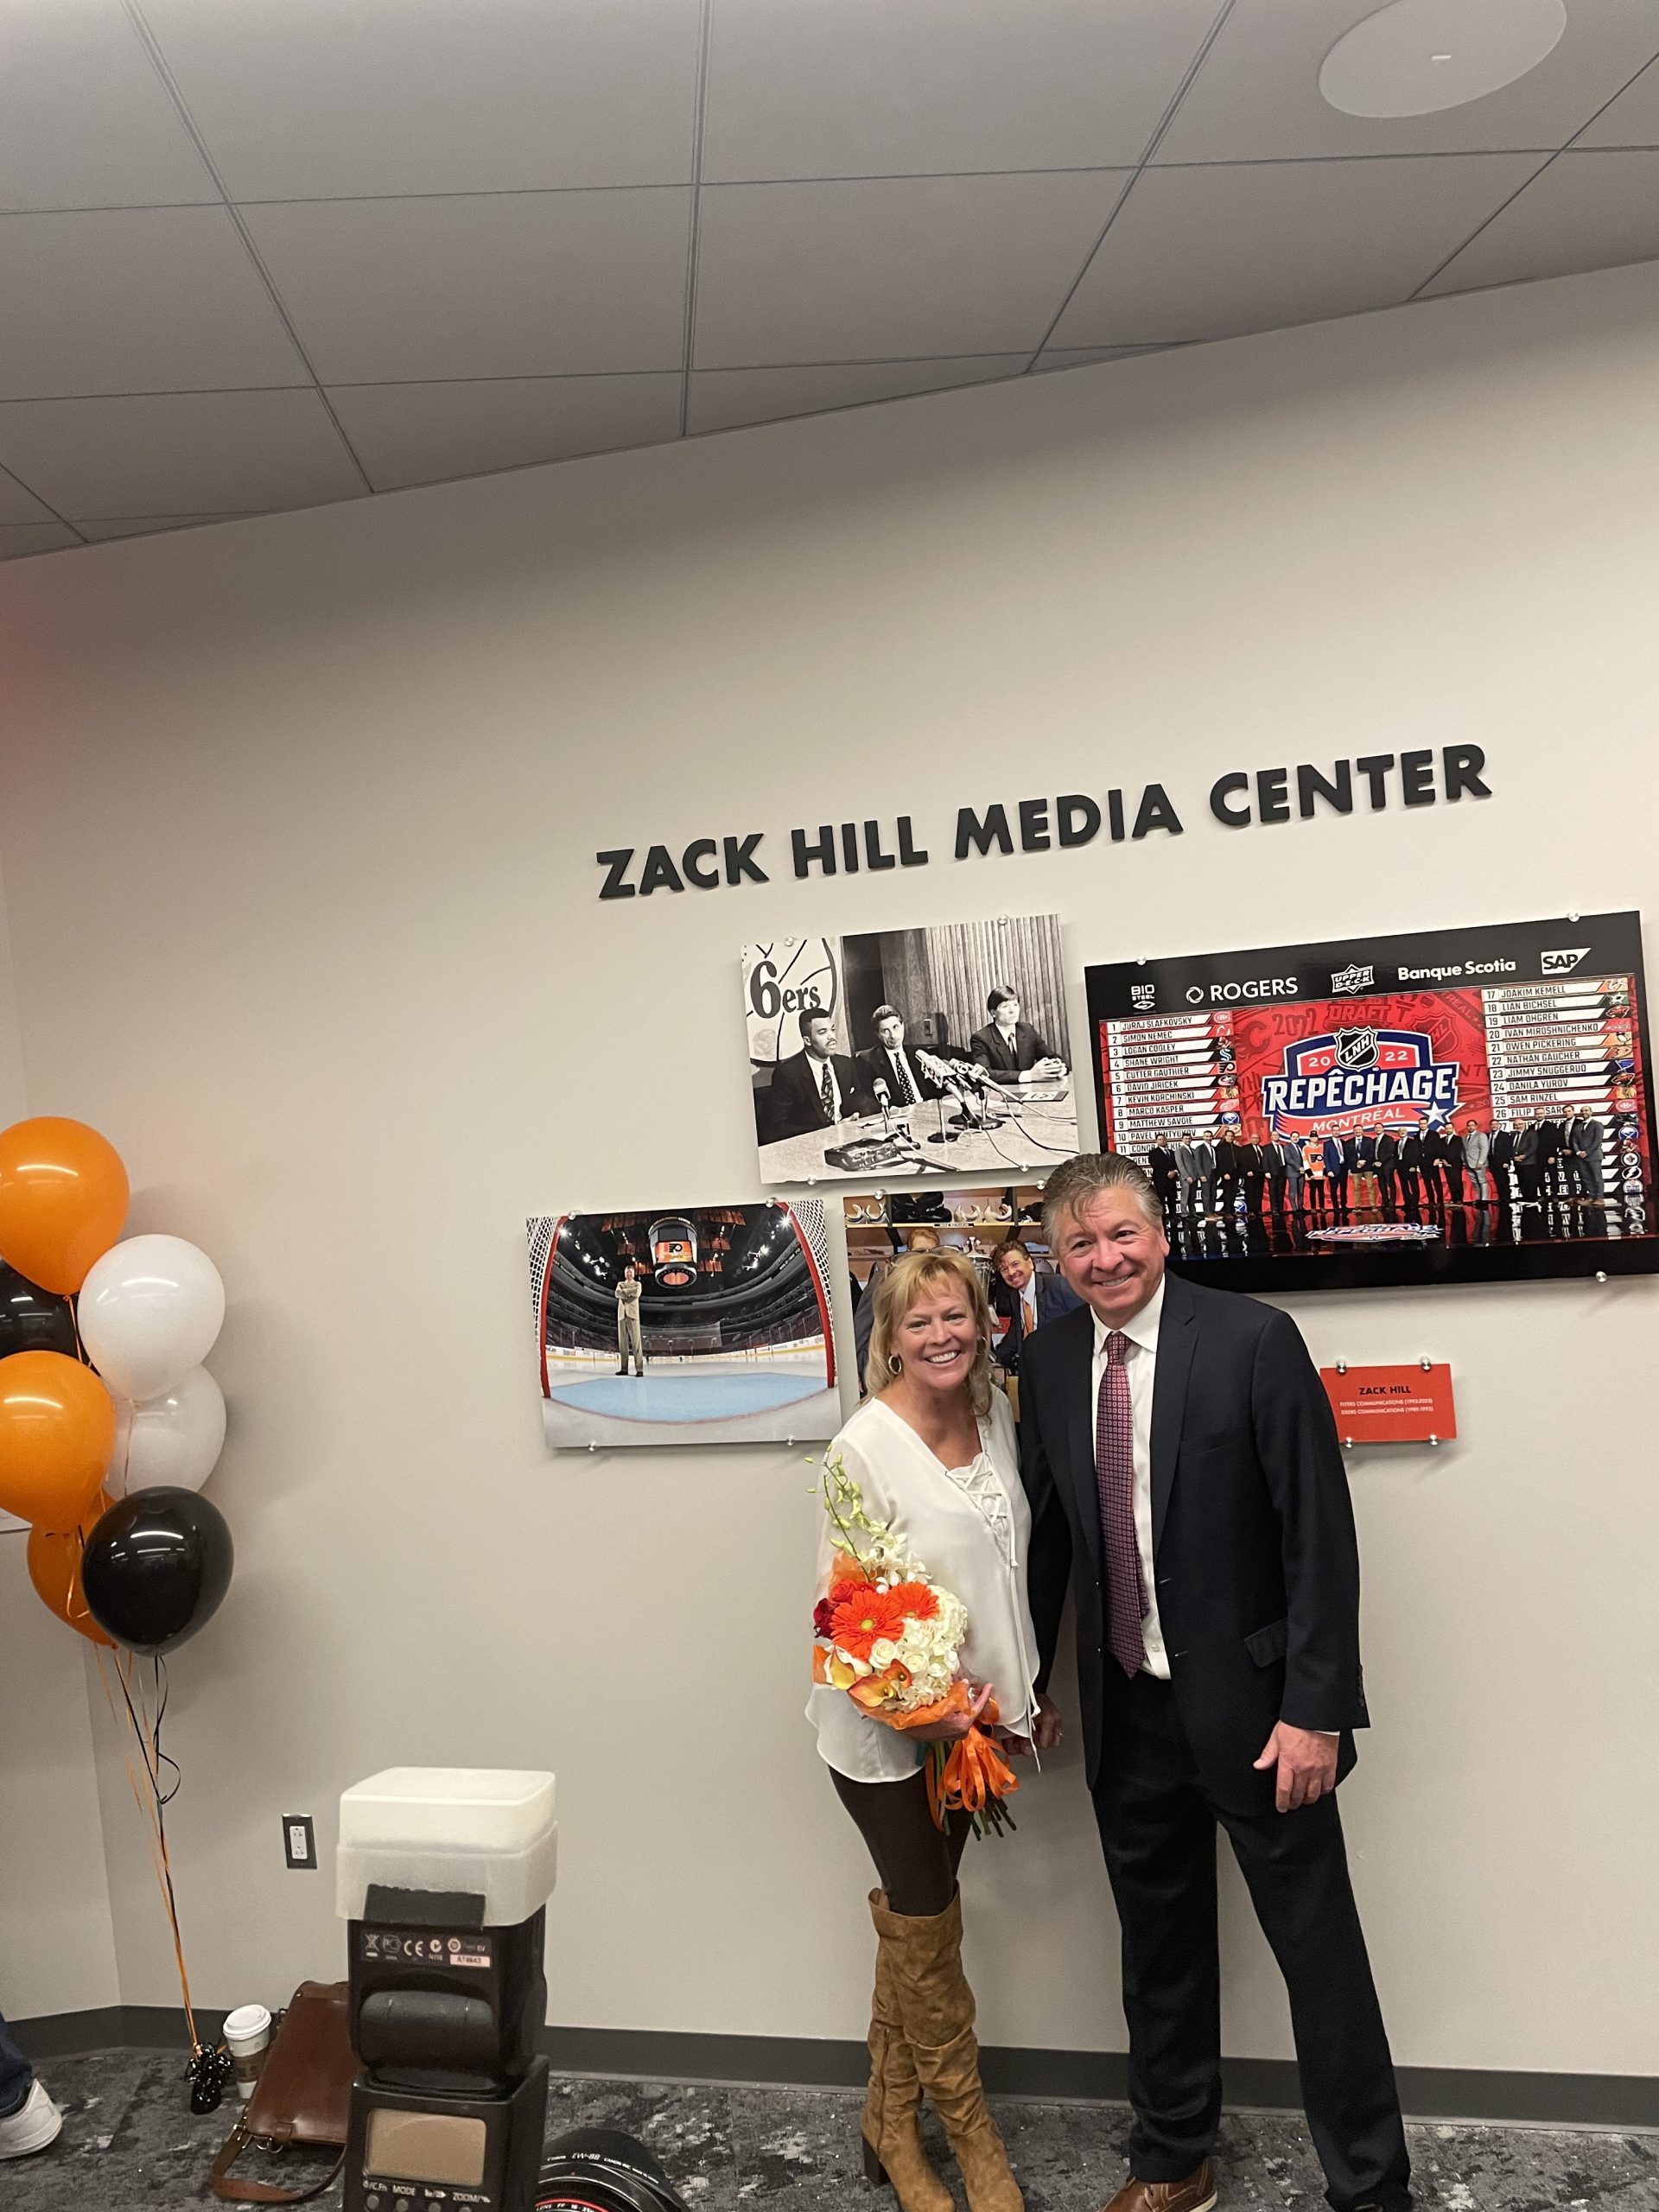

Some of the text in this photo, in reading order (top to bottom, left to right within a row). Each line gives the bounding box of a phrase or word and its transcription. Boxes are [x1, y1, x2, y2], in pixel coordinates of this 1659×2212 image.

[596, 744, 1492, 899] ZACK HILL MEDIA CENTER
[1543, 954, 1578, 969] SAP
[1335, 970, 1370, 982] UPPER
[1398, 959, 1516, 982] Banque Scotia
[750, 961, 821, 1019] 6ers
[1131, 984, 1154, 995] BIO
[1211, 977, 1298, 1001] ROGERS
[1502, 986, 1566, 998] JOAKIM KEMELL
[1503, 1000, 1557, 1011] LIAN BICHSEL
[1122, 1017, 1192, 1031] JURAJ SLAFKOVSKY
[1490, 1017, 1497, 1026] 19
[1503, 1013, 1558, 1024] LIAM OHGREN
[1505, 1023, 1599, 1037] IVAN MIROSHNICHENKO
[1123, 1033, 1147, 1042] SIMON
[1344, 1037, 1370, 1063] LNH
[1505, 1039, 1576, 1051] OWEN PICKERING
[1150, 1056, 1179, 1065] WRIGHT
[1308, 1051, 1408, 1067] 20 22
[1507, 1052, 1580, 1064] NATHAN GAUCHER
[1127, 1067, 1189, 1079] CUTTER GAUTHIER
[1493, 1070, 1503, 1078] 23
[1508, 1068, 1535, 1077] JIMMY
[1151, 1080, 1179, 1090] JIRICEK
[1268, 1068, 1453, 1111] REPÊCHAGE
[1510, 1079, 1568, 1090] DANILA YUROV
[1128, 1091, 1194, 1103] KEVIN KORCHINSKI
[1510, 1092, 1558, 1103] SAM RINZEL
[1129, 1105, 1184, 1116] MARCO KASPER
[1512, 1108, 1531, 1116] FILIP
[1130, 1116, 1192, 1128] MATTHEW SAVOIE
[1313, 1108, 1405, 1132] MONTRÉAL
[1131, 1132, 1153, 1141] PAVEL
[393, 2185, 416, 2196] MODE
